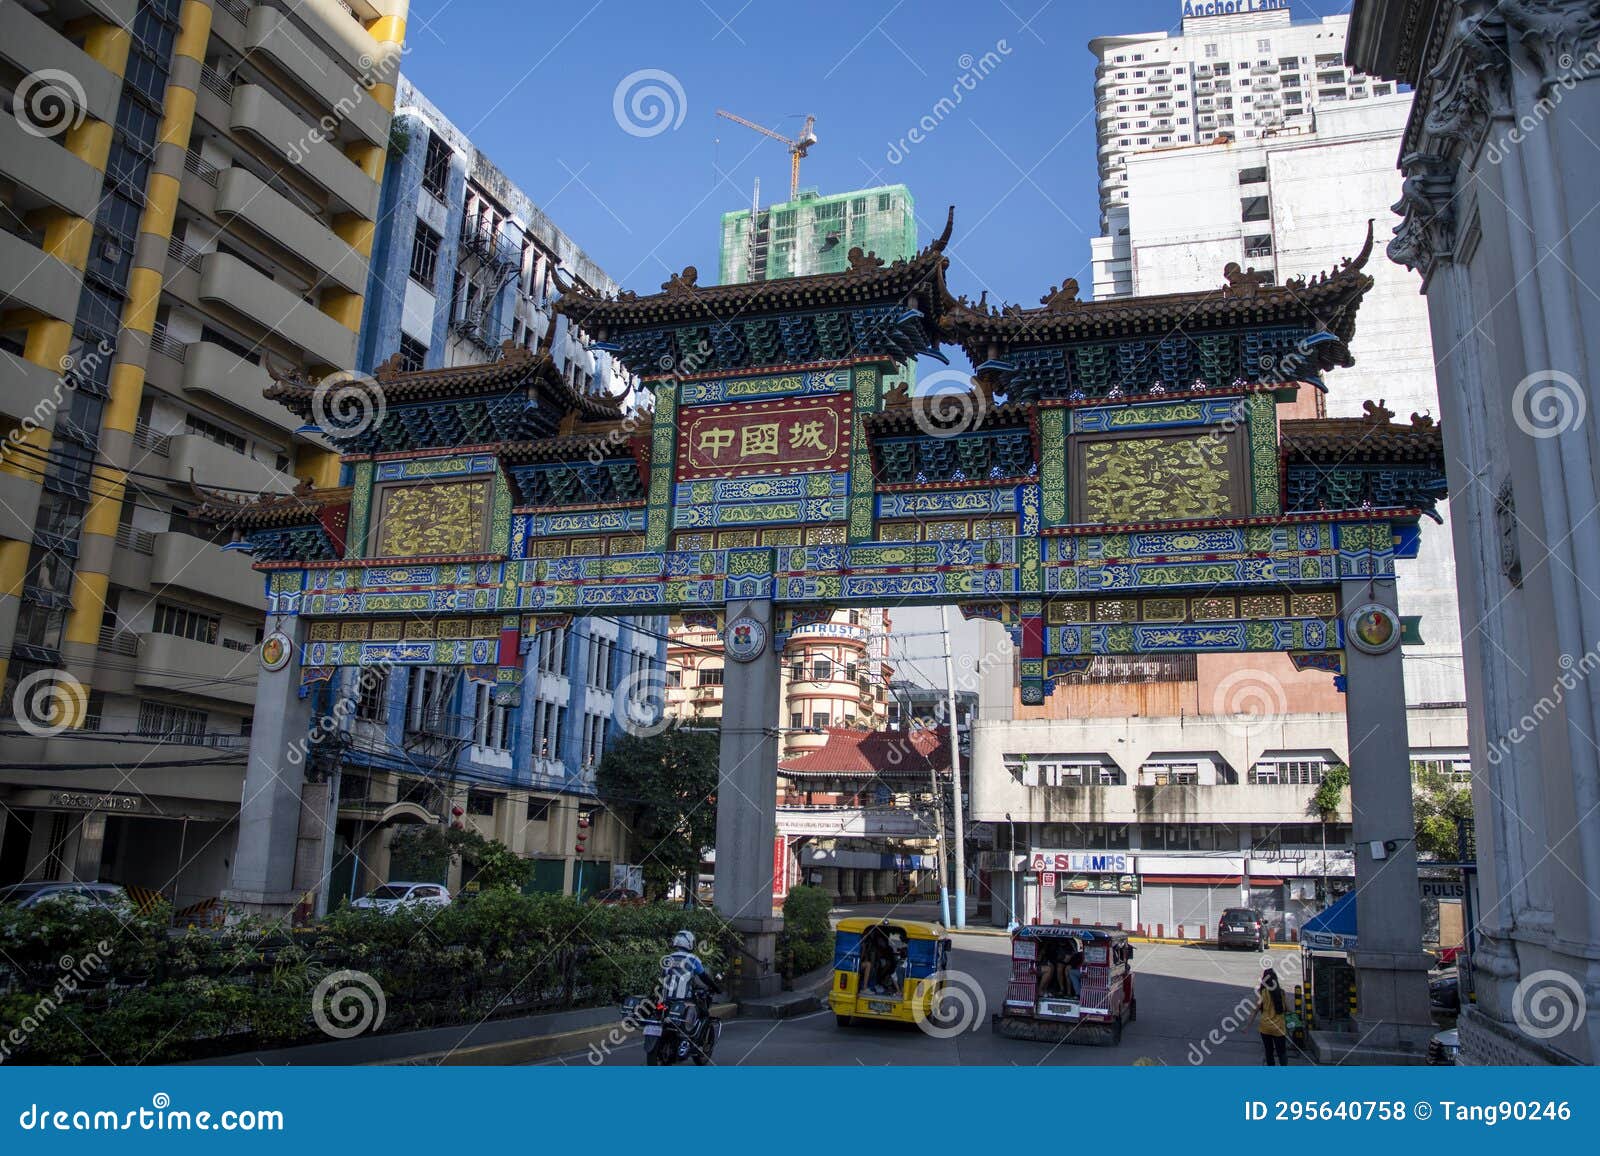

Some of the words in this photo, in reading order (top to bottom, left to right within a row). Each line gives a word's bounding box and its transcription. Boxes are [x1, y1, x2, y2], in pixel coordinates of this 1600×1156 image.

[1183, 0, 1242, 17] Anchor
[699, 420, 828, 459] 中國城
[1072, 855, 1125, 870] LAMPS
